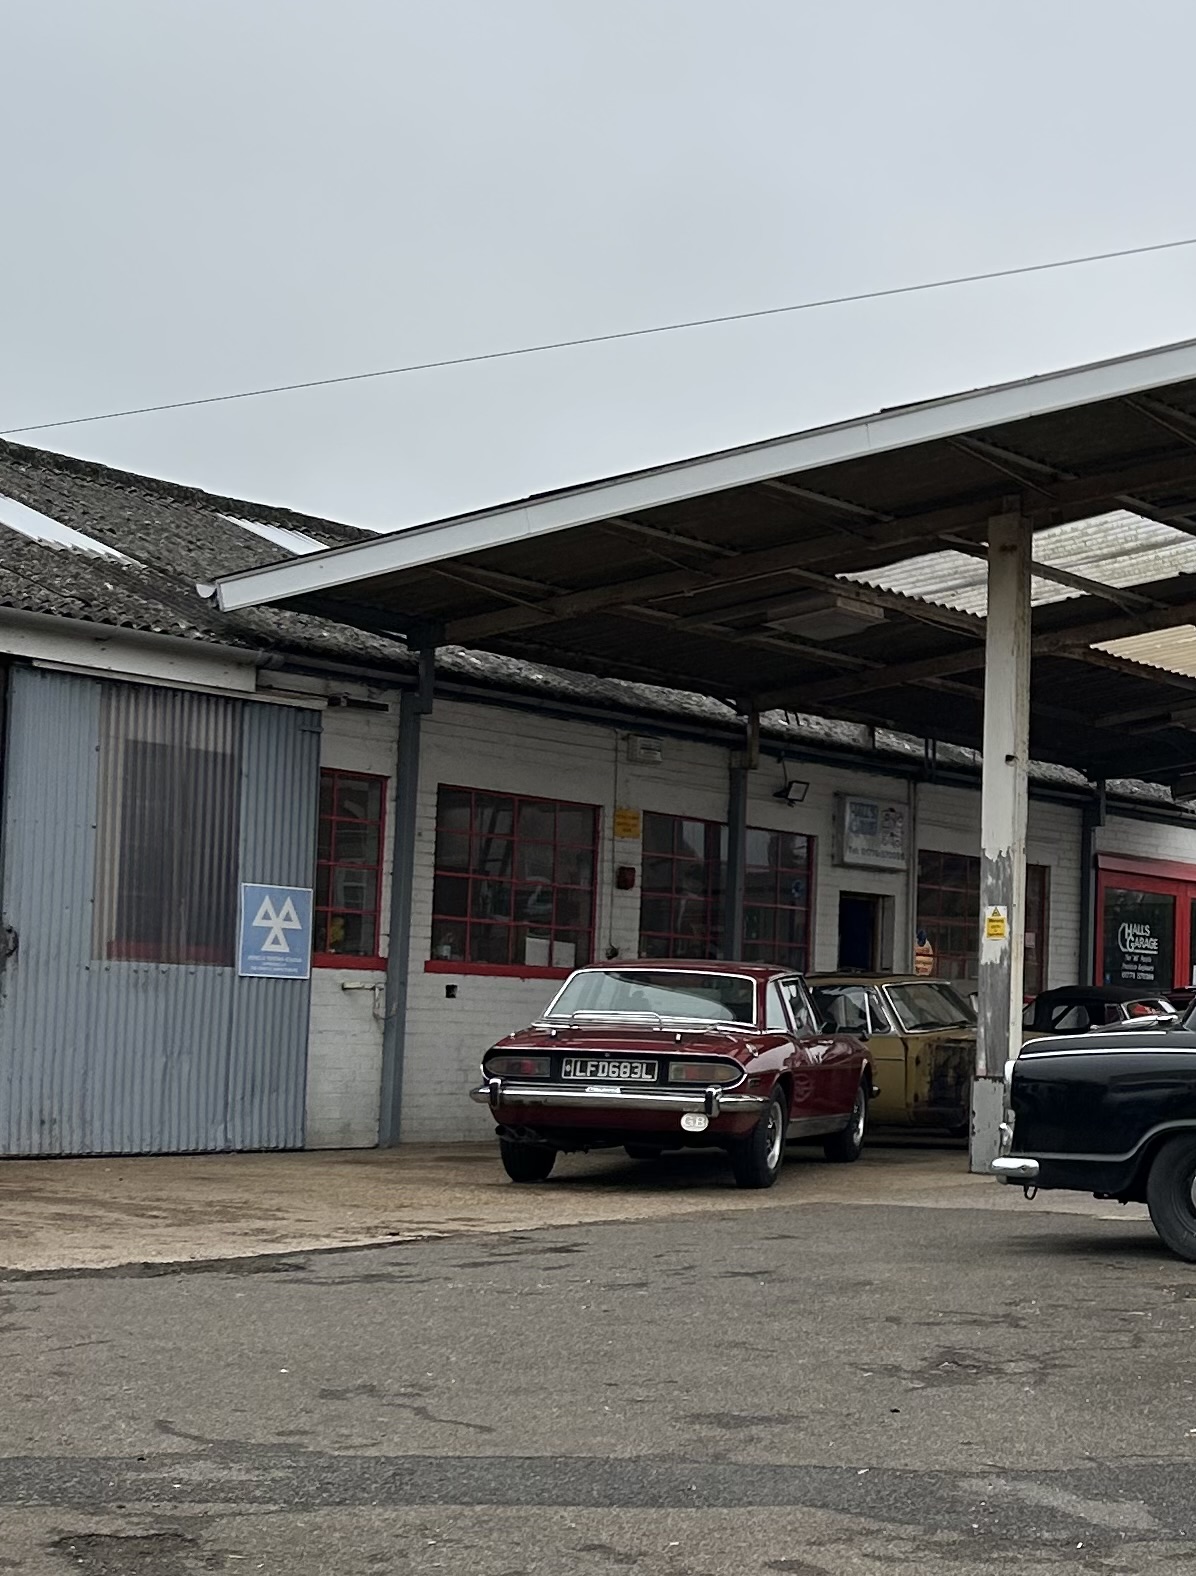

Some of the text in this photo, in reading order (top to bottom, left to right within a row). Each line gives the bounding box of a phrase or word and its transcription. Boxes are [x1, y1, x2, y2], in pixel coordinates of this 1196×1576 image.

[1125, 922, 1151, 939] HALLS
[1126, 936, 1159, 952] GARAGE
[575, 1061, 653, 1079] LFD683L
[685, 1115, 706, 1127] GB
